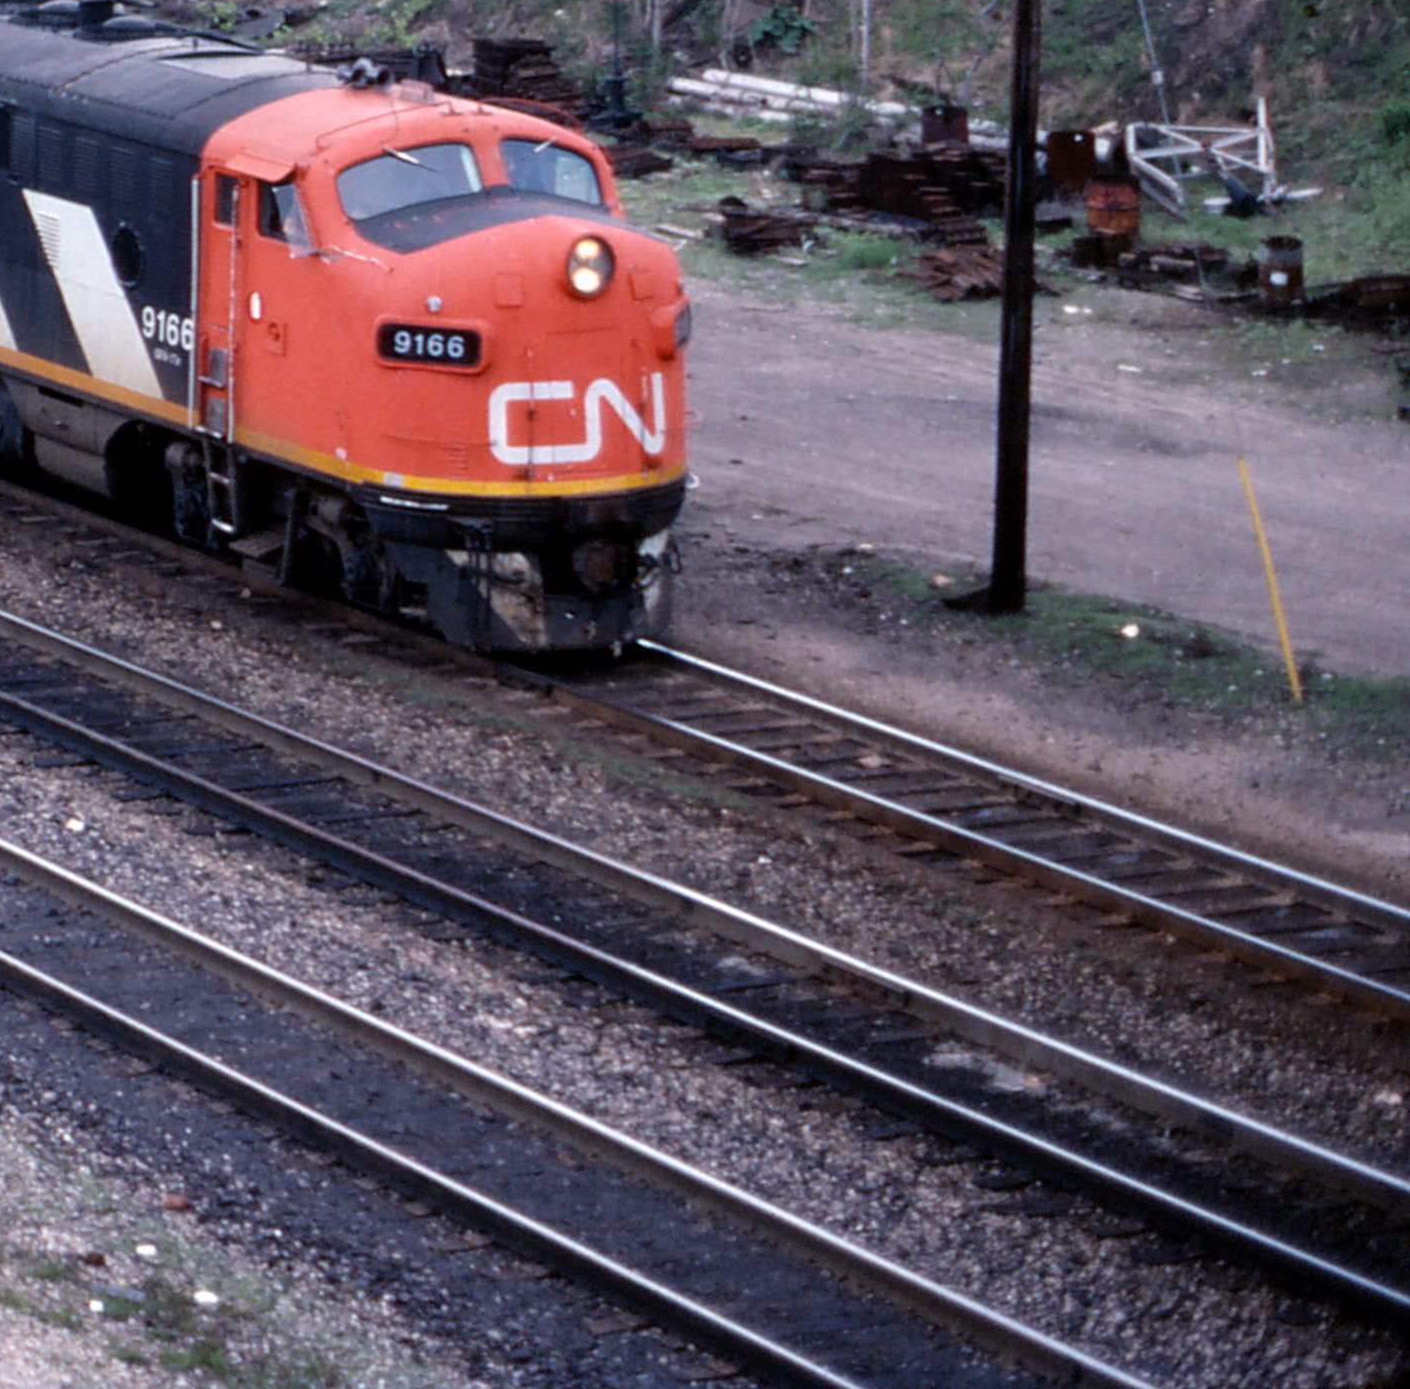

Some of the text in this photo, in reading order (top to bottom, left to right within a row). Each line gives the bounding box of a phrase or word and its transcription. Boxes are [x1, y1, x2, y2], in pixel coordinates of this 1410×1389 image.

[142, 306, 195, 351] 9166
[394, 330, 465, 358] 9166
[489, 372, 665, 464] CN
